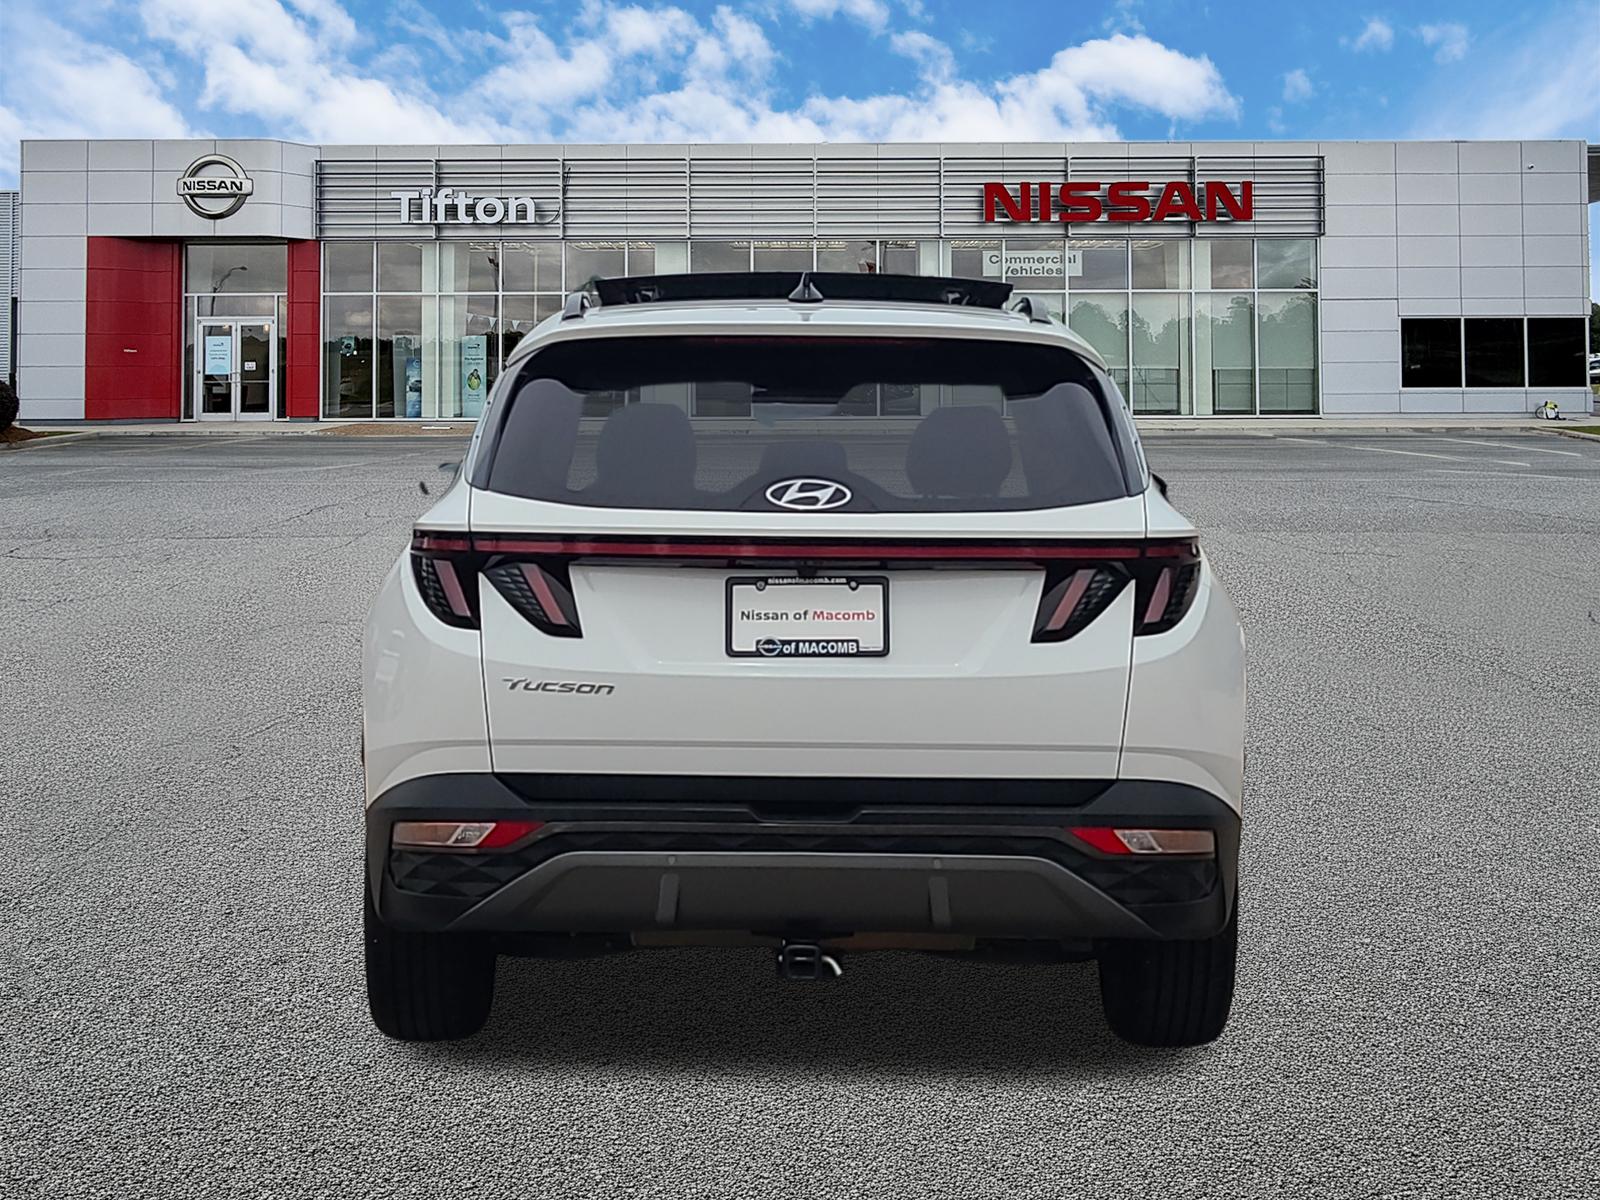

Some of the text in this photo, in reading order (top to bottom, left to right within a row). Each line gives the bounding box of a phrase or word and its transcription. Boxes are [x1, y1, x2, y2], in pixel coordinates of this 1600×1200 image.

[182, 180, 243, 191] NISSAN
[391, 187, 536, 224] Tifton
[983, 181, 1253, 222] NISSAN
[740, 609, 875, 621] Nissan of Macomb
[782, 642, 796, 654] of
[798, 642, 857, 654] MACOMB
